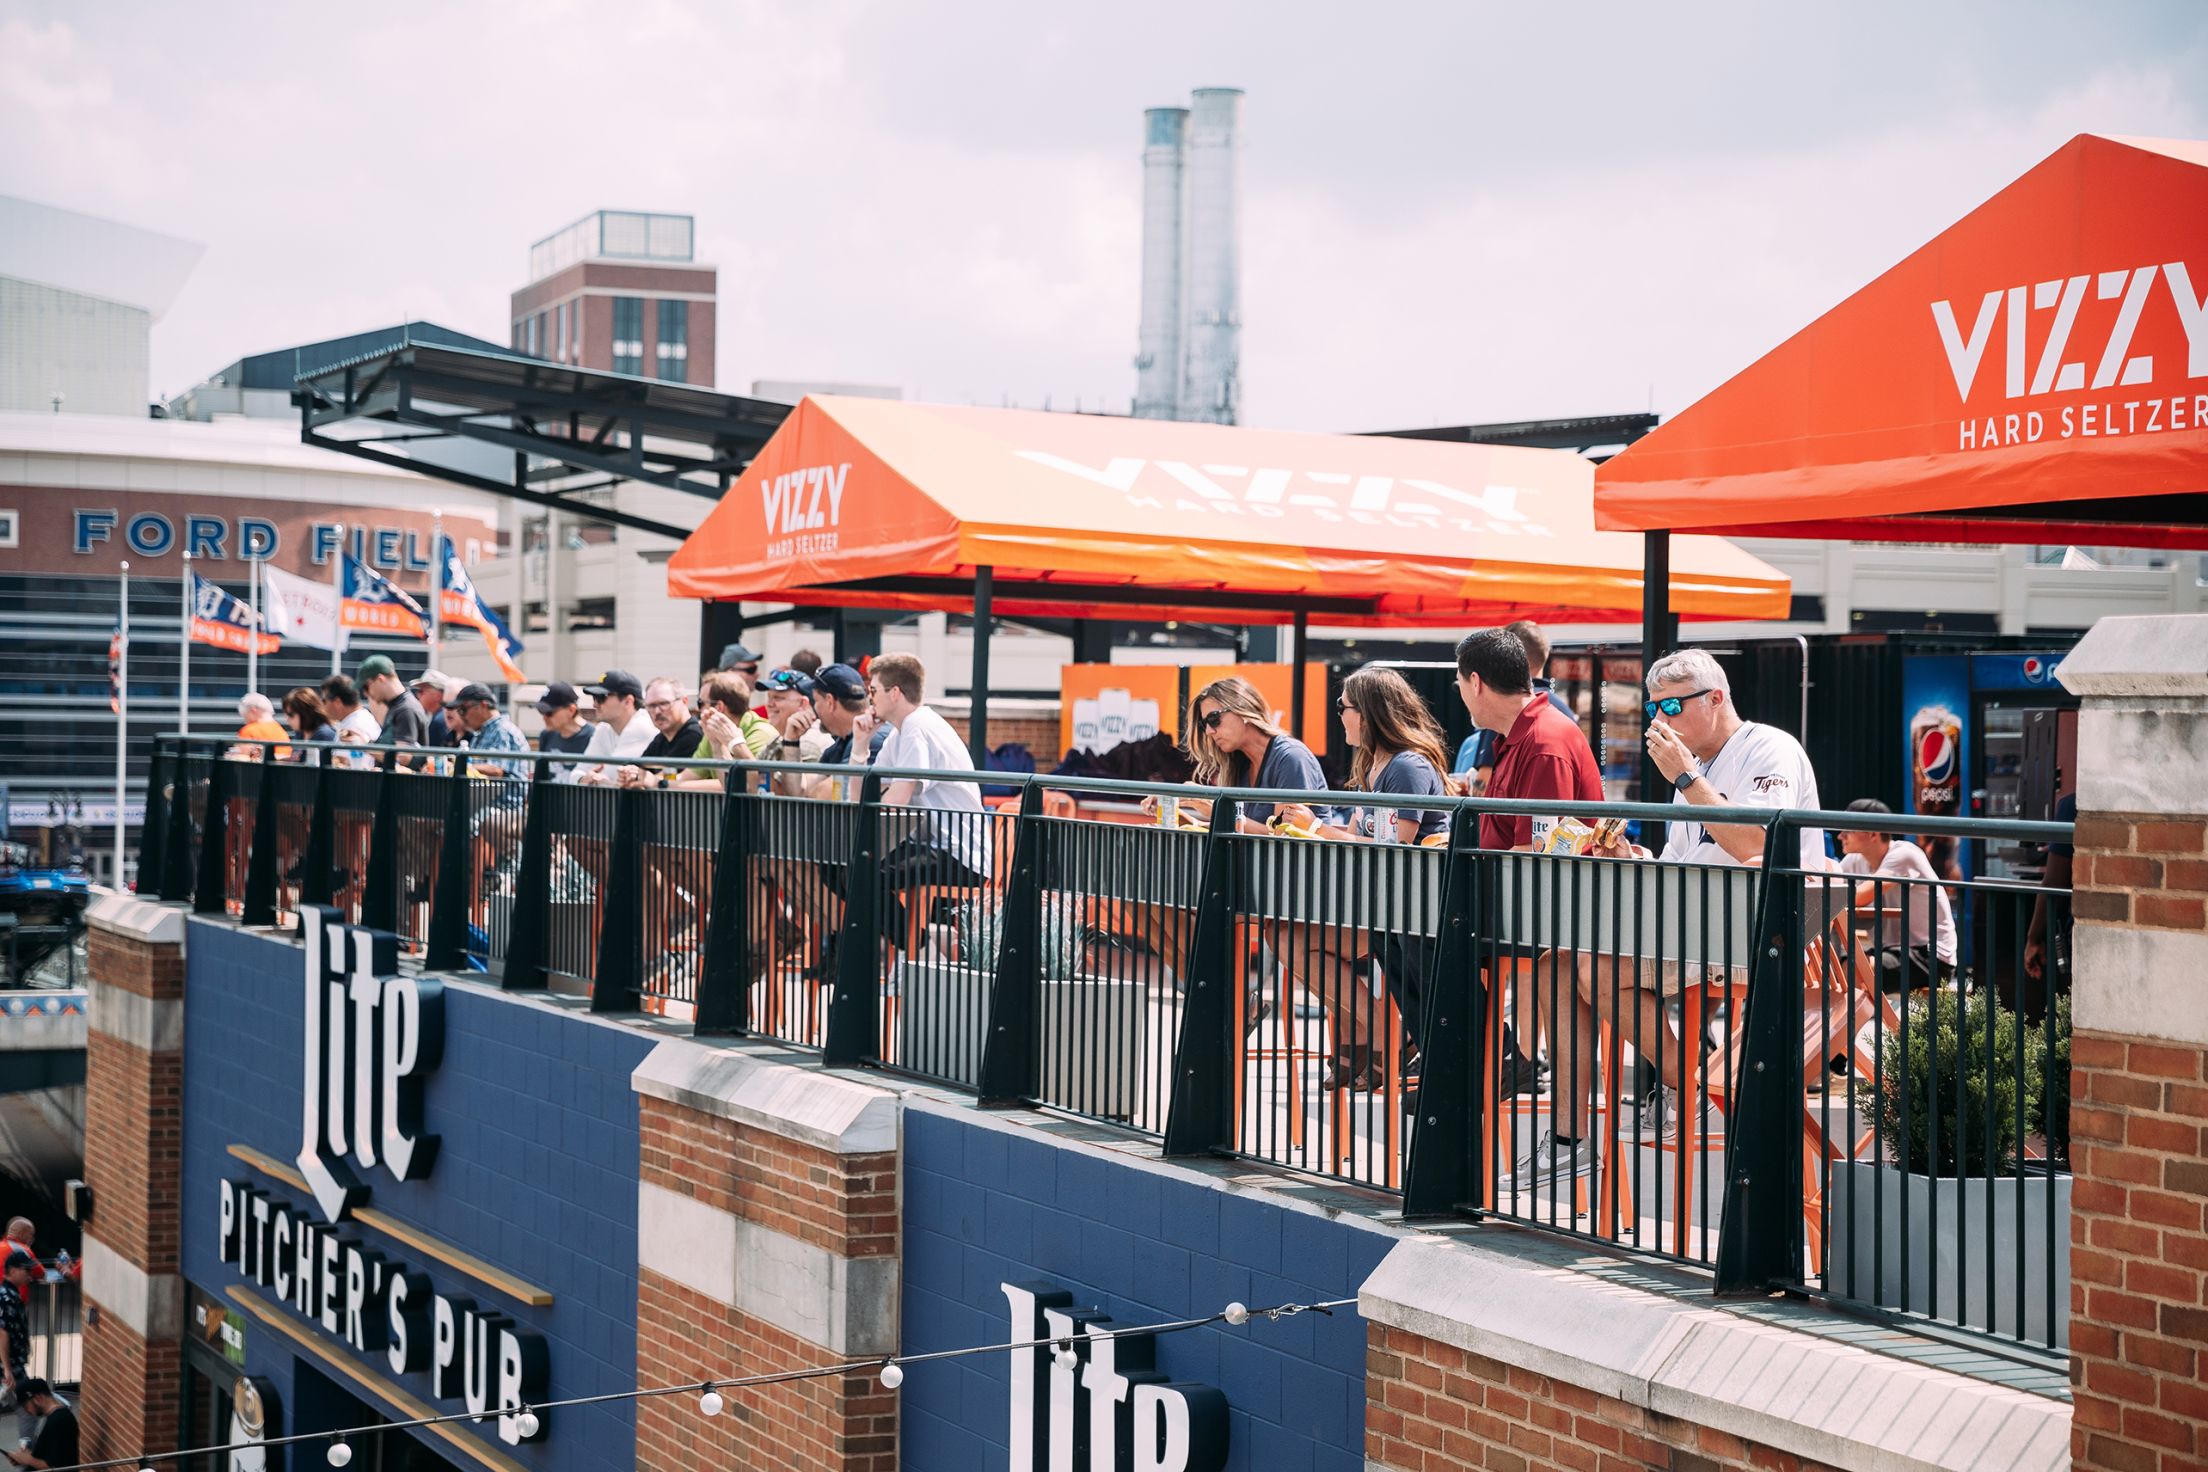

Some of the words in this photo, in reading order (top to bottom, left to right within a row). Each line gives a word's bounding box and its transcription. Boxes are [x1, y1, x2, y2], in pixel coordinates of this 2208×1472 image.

[1930, 261, 2208, 404] VIZZY
[1959, 411, 2044, 450] HARD
[2060, 394, 2208, 439] SELTZER
[761, 463, 850, 536] VIZZY
[73, 508, 280, 562] FORD
[311, 521, 437, 572] FIEL
[1752, 775, 1789, 793] Tigers
[1921, 786, 1954, 805] pepsi
[219, 1178, 408, 1376] PITCHER'S
[433, 1294, 522, 1447] PUB
